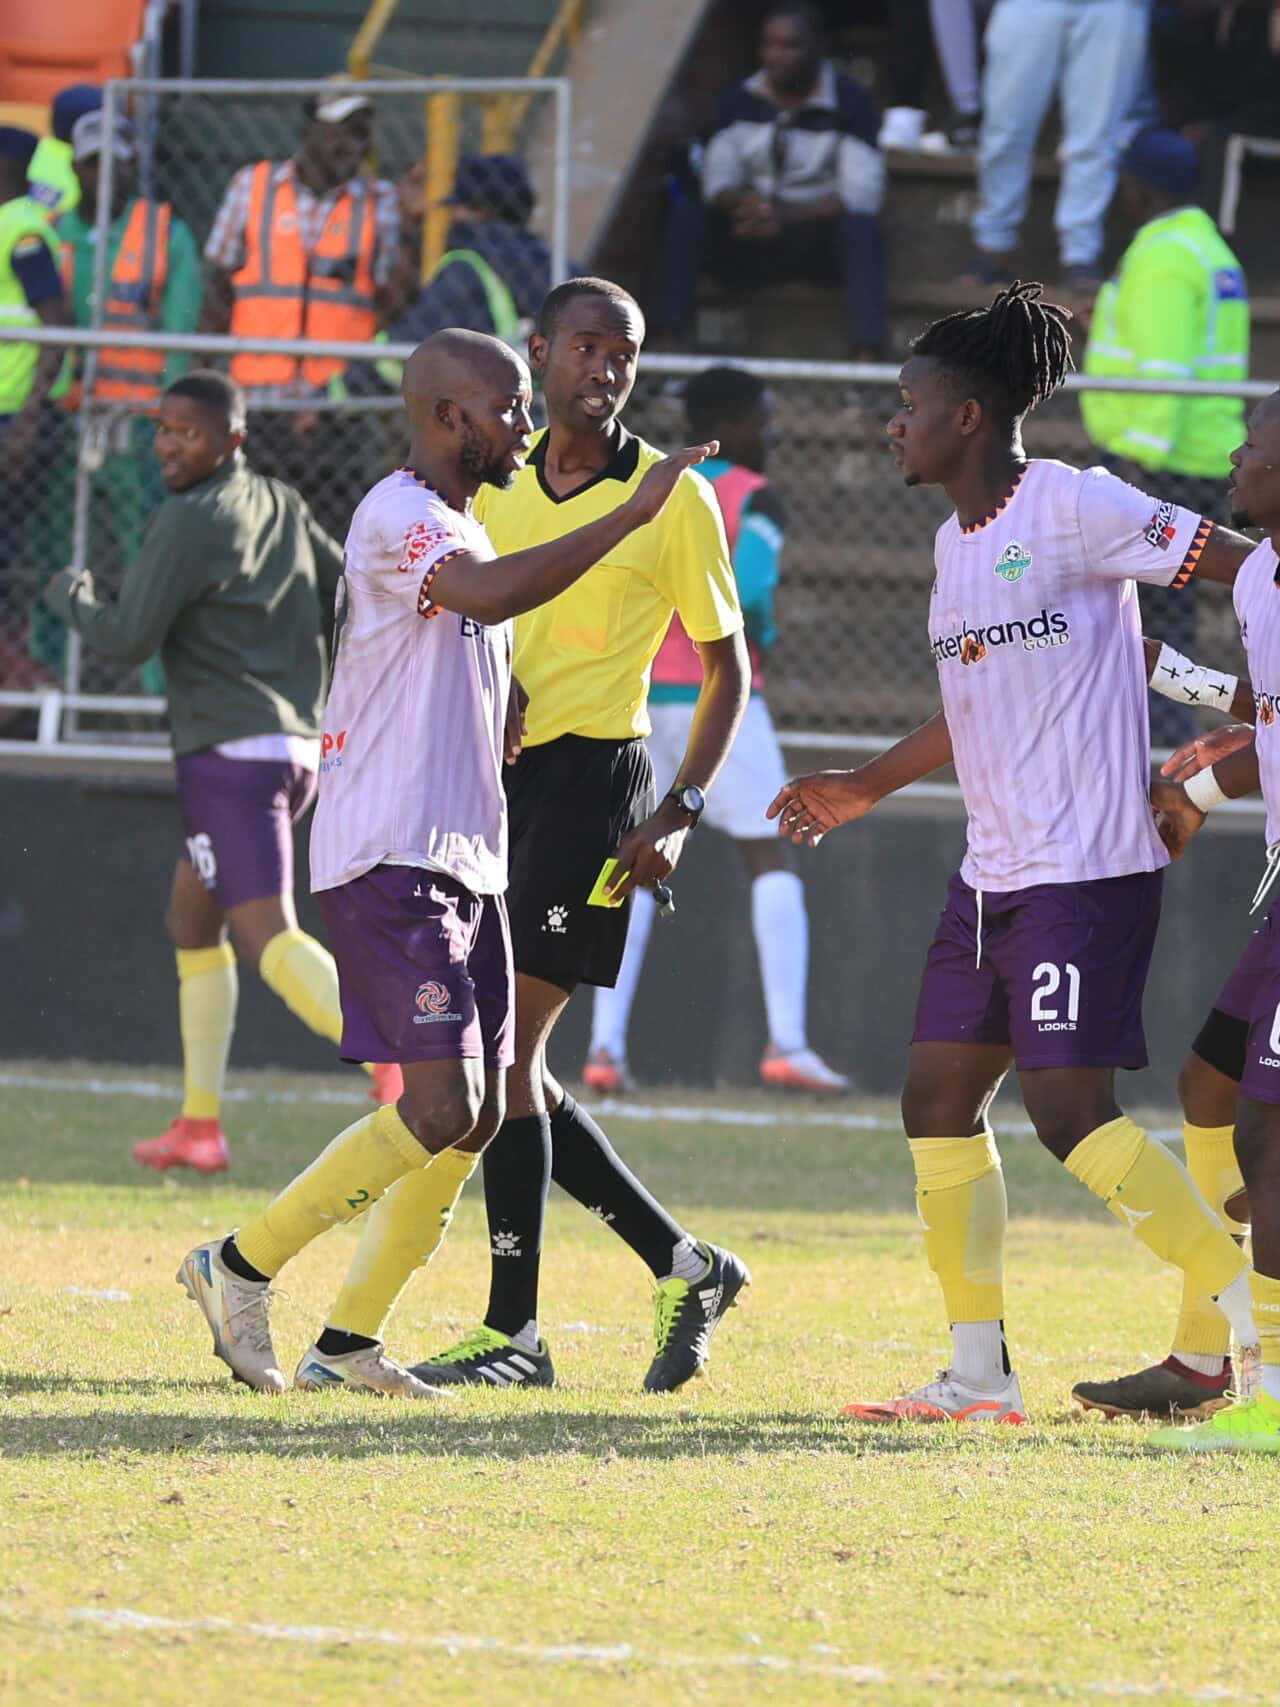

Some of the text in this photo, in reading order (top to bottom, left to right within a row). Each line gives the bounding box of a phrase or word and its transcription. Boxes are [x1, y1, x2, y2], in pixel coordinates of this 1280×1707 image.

[1024, 632, 1070, 651] GOLD
[1032, 962, 1080, 1021] 21
[1038, 1022, 1077, 1032] LOOKS
